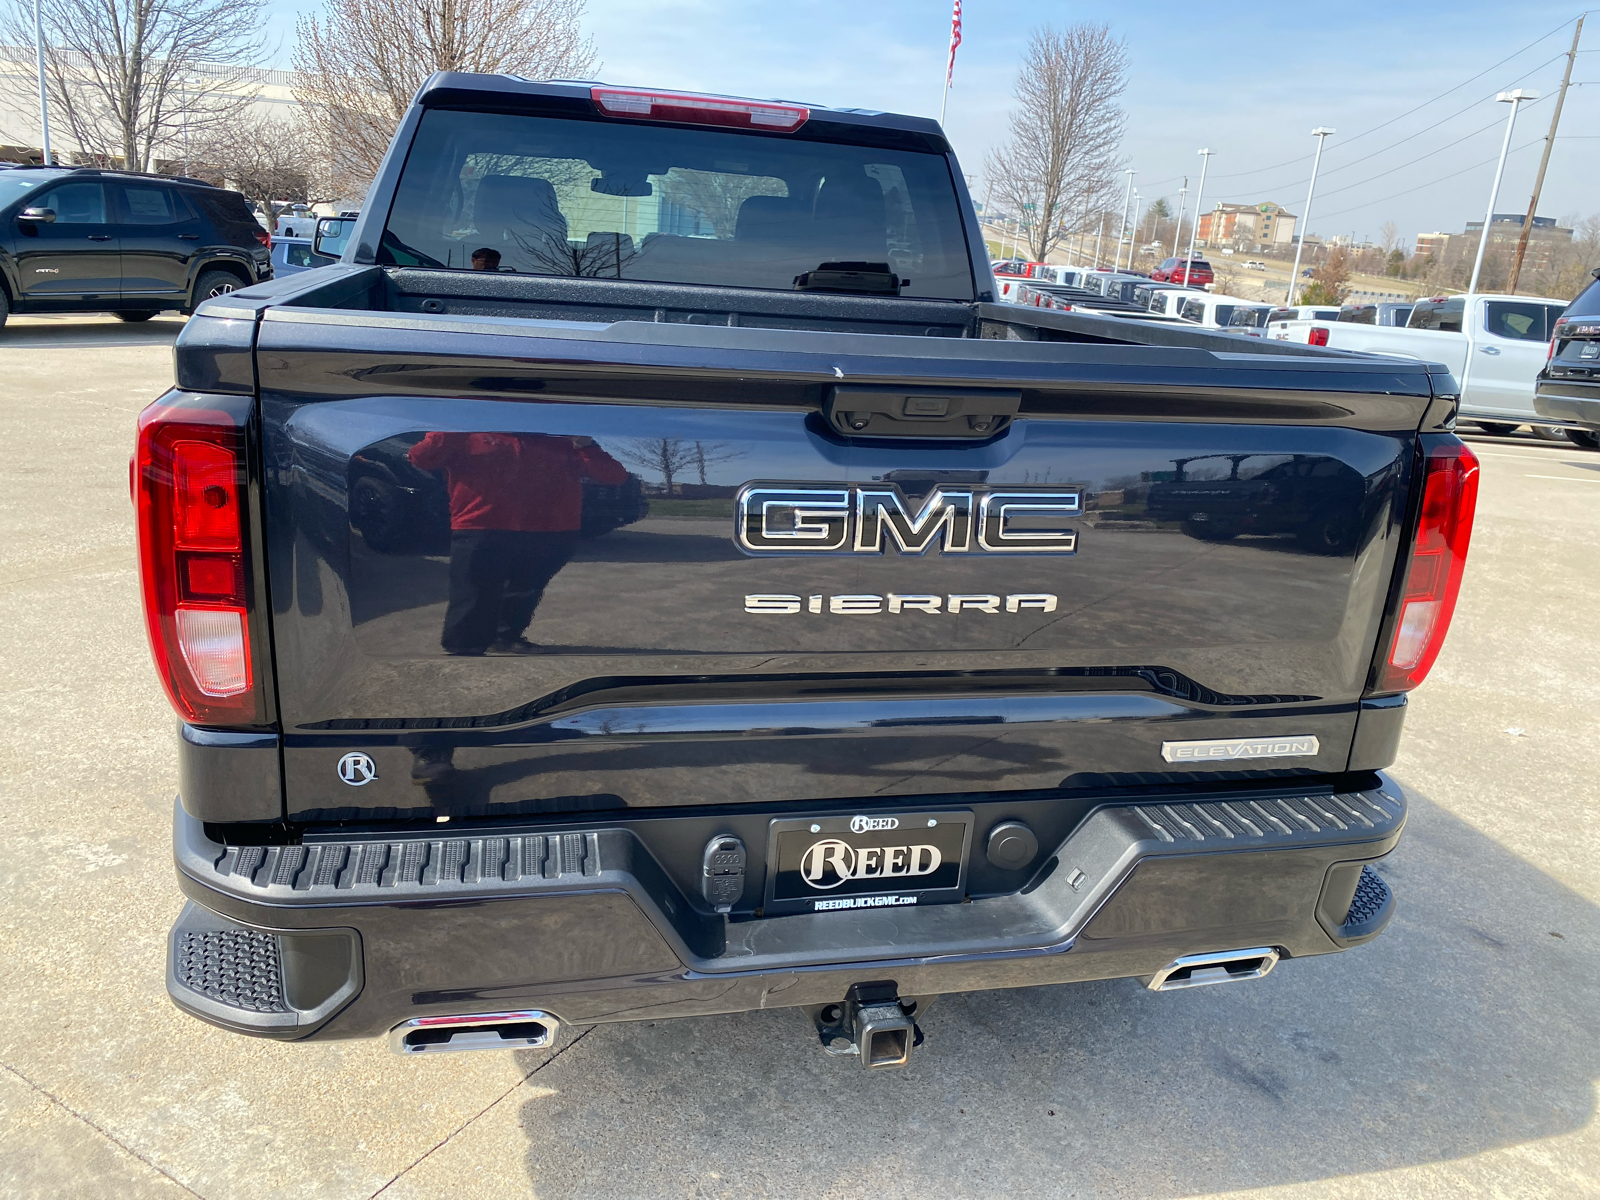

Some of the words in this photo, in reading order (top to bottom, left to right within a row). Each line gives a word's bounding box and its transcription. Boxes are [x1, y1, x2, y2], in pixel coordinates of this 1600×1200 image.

[736, 482, 1083, 555] GMC
[744, 594, 1058, 614] SIERRA
[1175, 742, 1309, 759] ELEVATION
[337, 751, 379, 787] R
[850, 815, 899, 834] REED
[800, 838, 942, 890] REED
